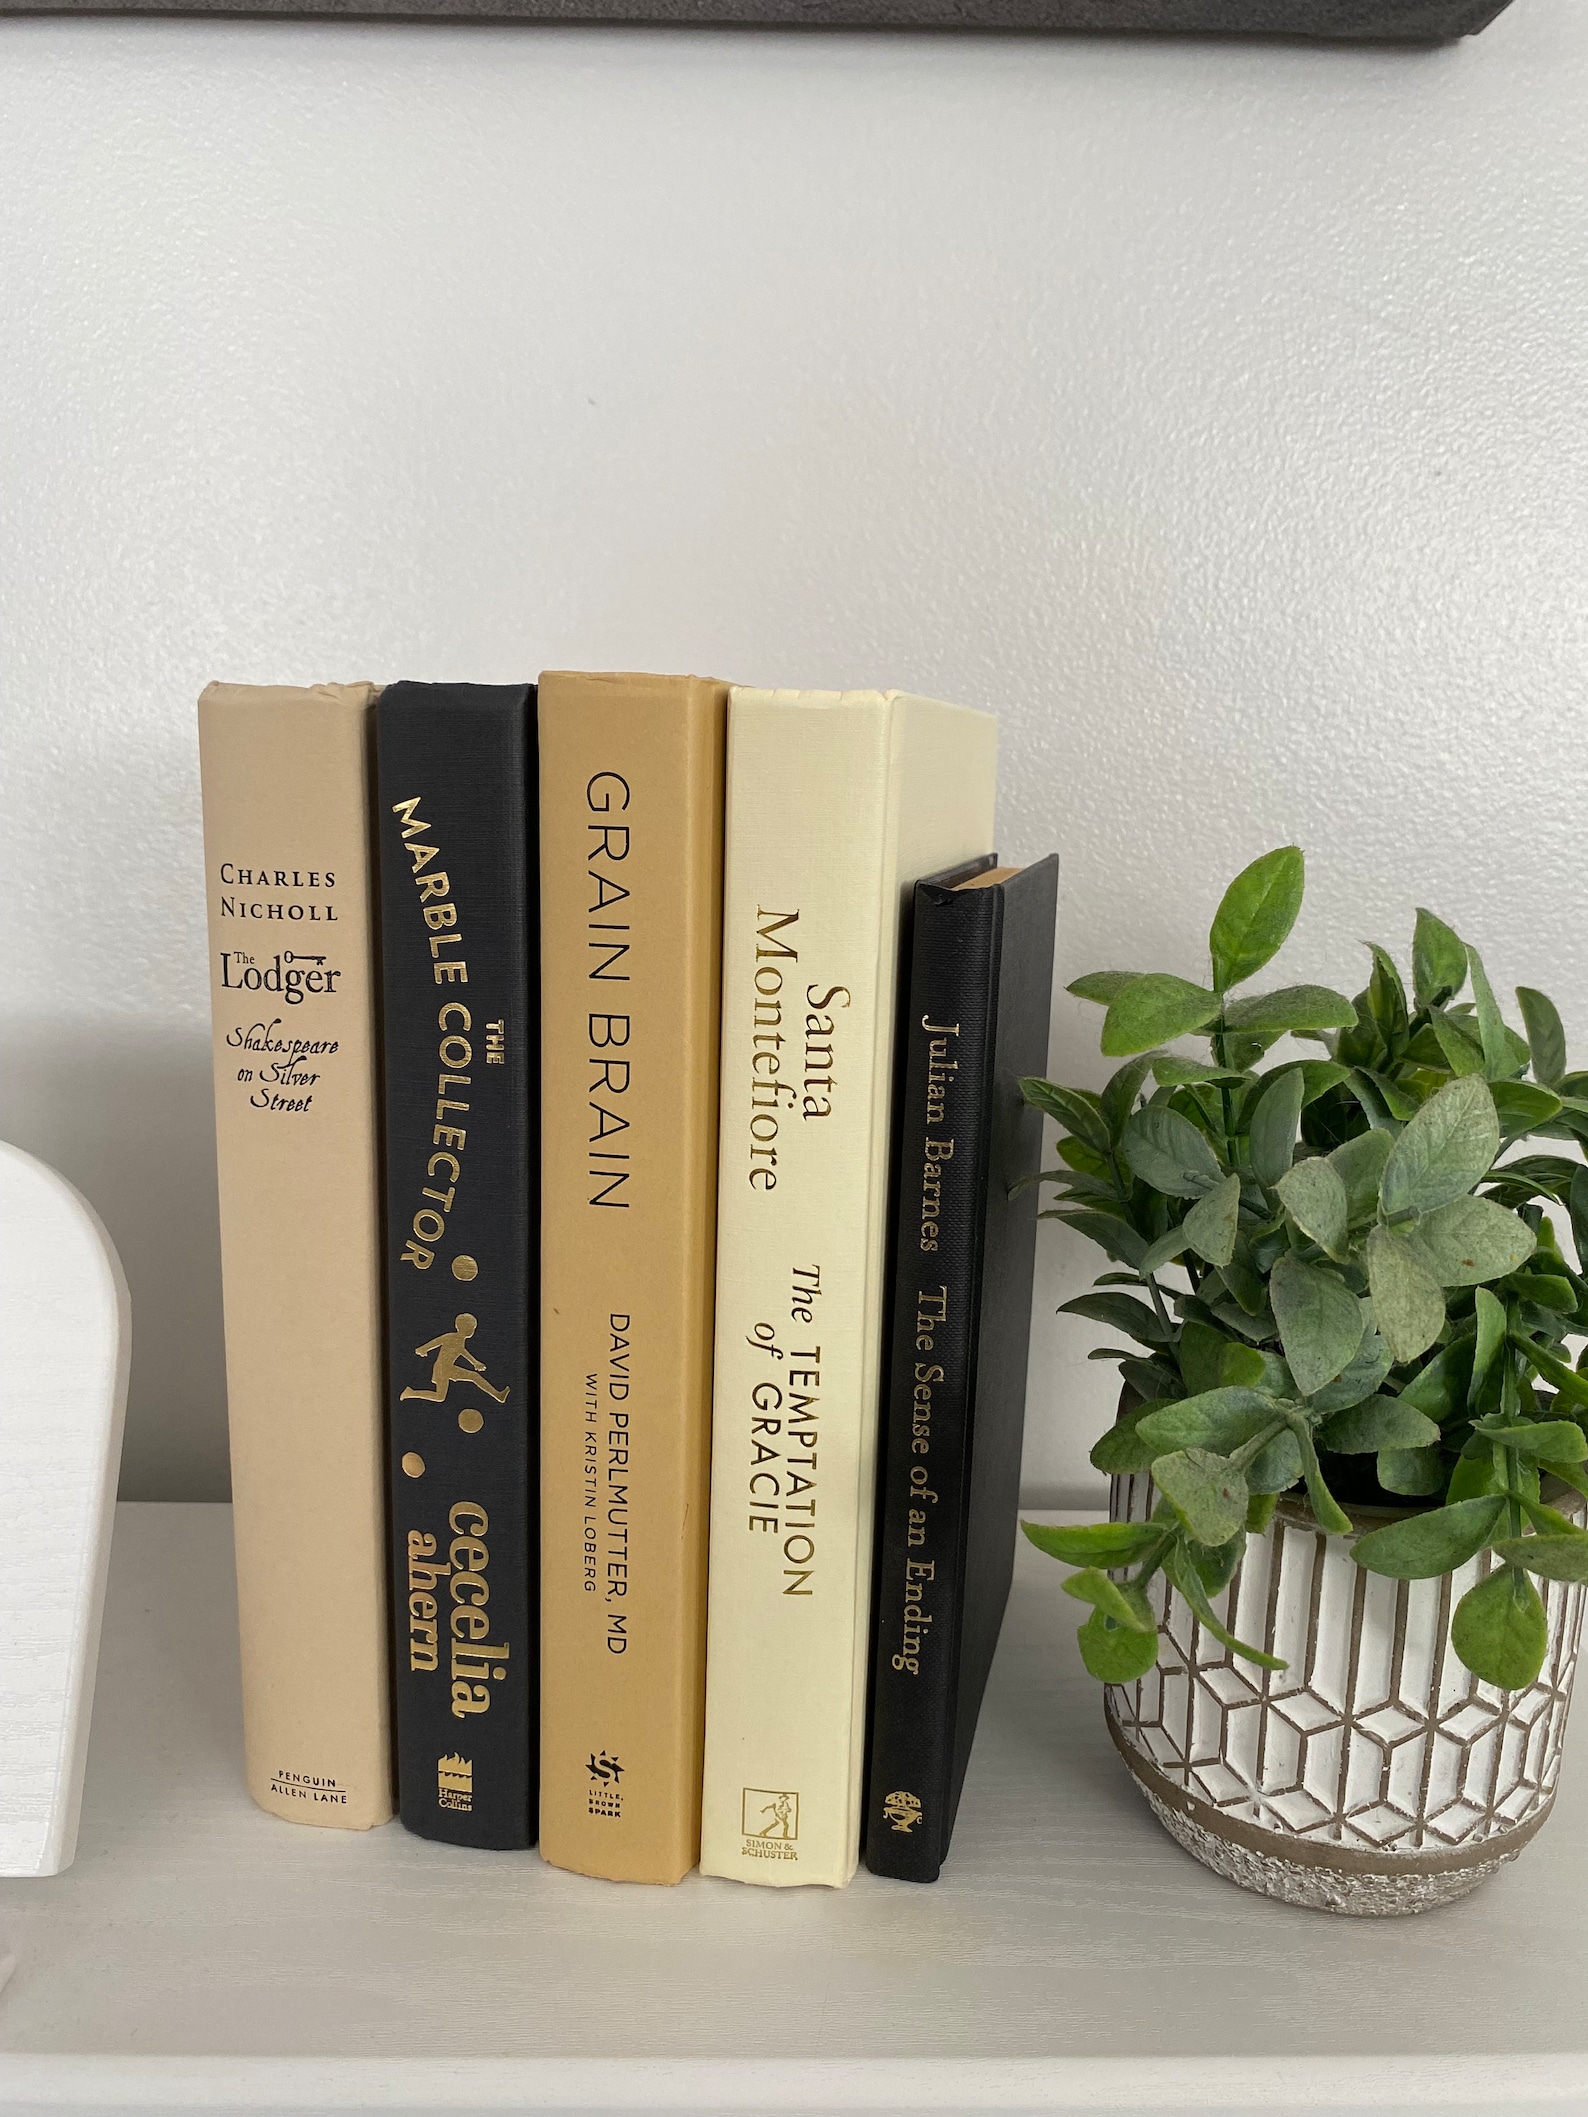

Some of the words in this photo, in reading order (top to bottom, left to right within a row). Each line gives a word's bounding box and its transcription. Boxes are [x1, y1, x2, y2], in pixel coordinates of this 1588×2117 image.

[220, 863, 336, 888] CHARLES
[391, 795, 469, 985] MARBLE
[586, 771, 630, 981] GRAIN
[220, 897, 338, 921] NICHOLL
[220, 952, 341, 1005] Lodger
[233, 951, 255, 965] The
[226, 1018, 339, 1062] Shakespeare
[485, 1018, 504, 1065] THE
[749, 904, 799, 1191] Montefiore
[802, 983, 851, 1121] Santa
[237, 1068, 253, 1082] on
[259, 1055, 320, 1086] Silver
[921, 1014, 960, 1125] Julian
[250, 1088, 312, 1112] Street
[588, 1013, 630, 1208] BRAIN
[399, 1001, 472, 1270] COLLECTOR
[920, 1136, 954, 1252] Barnes
[790, 1263, 822, 1323] The
[916, 1285, 948, 1351] The
[609, 1313, 630, 1401] DAVID
[745, 1322, 784, 1361] of
[585, 1373, 598, 1422] WITH
[912, 1362, 945, 1454] Sense
[584, 1431, 597, 1507] KRISTIN
[749, 1382, 783, 1533] GRACIE
[782, 1346, 821, 1595] TEMPTATION
[605, 1412, 629, 1602] PERLMUTTER,
[910, 1466, 939, 1504] of
[584, 1516, 597, 1592] LOBERG
[908, 1508, 926, 1547] an
[406, 1528, 451, 1672] ahern
[449, 1501, 510, 1719] cecelia
[892, 1558, 935, 1676] Ending
[607, 1614, 627, 1654] MD
[270, 1783, 307, 1799] ALLEN
[313, 1792, 347, 1804] LANE
[278, 1770, 336, 1788] PENGUIN
[438, 1788, 473, 1802] Harper
[438, 1798, 473, 1812] Collins
[588, 1798, 621, 1808] BROWN
[588, 1807, 621, 1818] SPARK
[741, 1846, 798, 1861] SCHUSTER
[745, 1838, 782, 1850] SIMON
[783, 1842, 793, 1851] &
